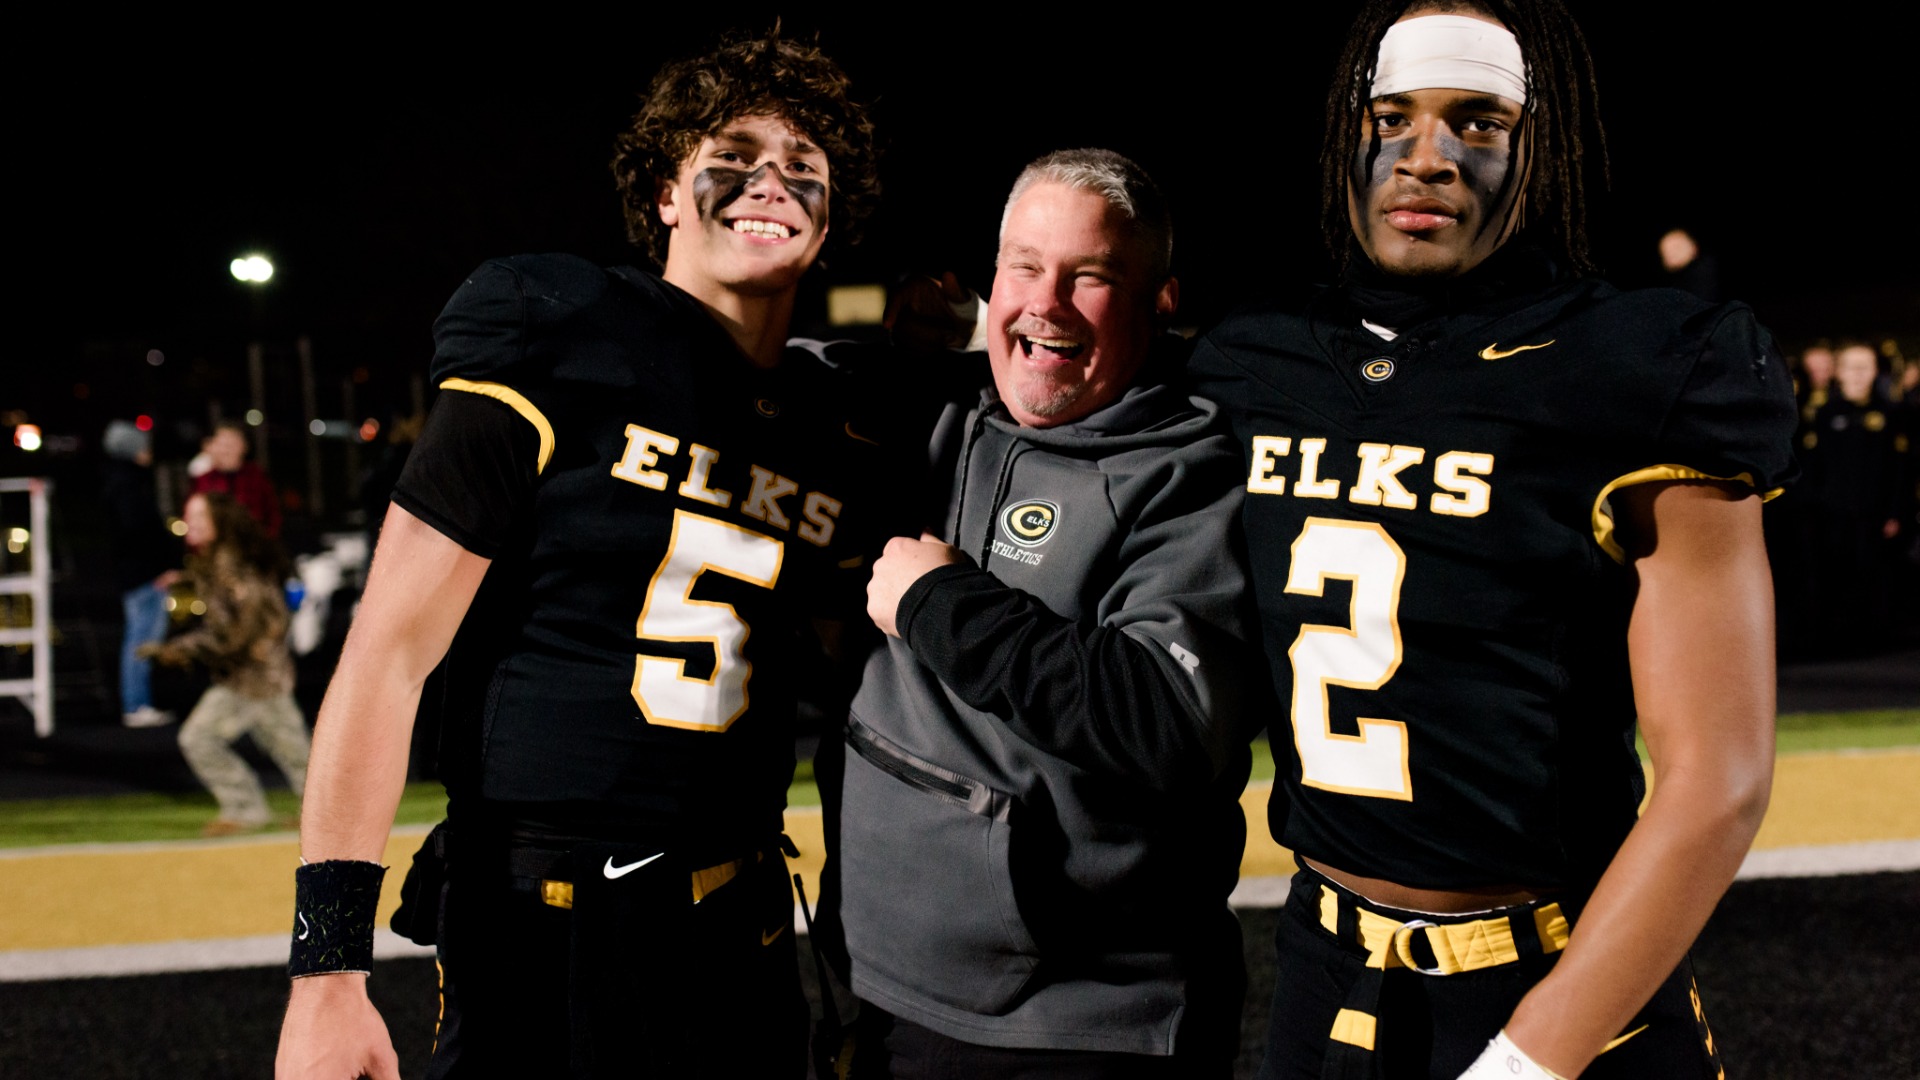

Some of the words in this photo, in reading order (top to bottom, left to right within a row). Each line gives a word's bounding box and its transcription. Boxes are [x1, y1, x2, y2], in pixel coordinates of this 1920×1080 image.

[611, 423, 843, 547] ELKS
[1026, 515, 1050, 527] ELKS
[1247, 435, 1494, 518] ELKS
[631, 508, 784, 733] 5
[1283, 516, 1413, 802] 2
